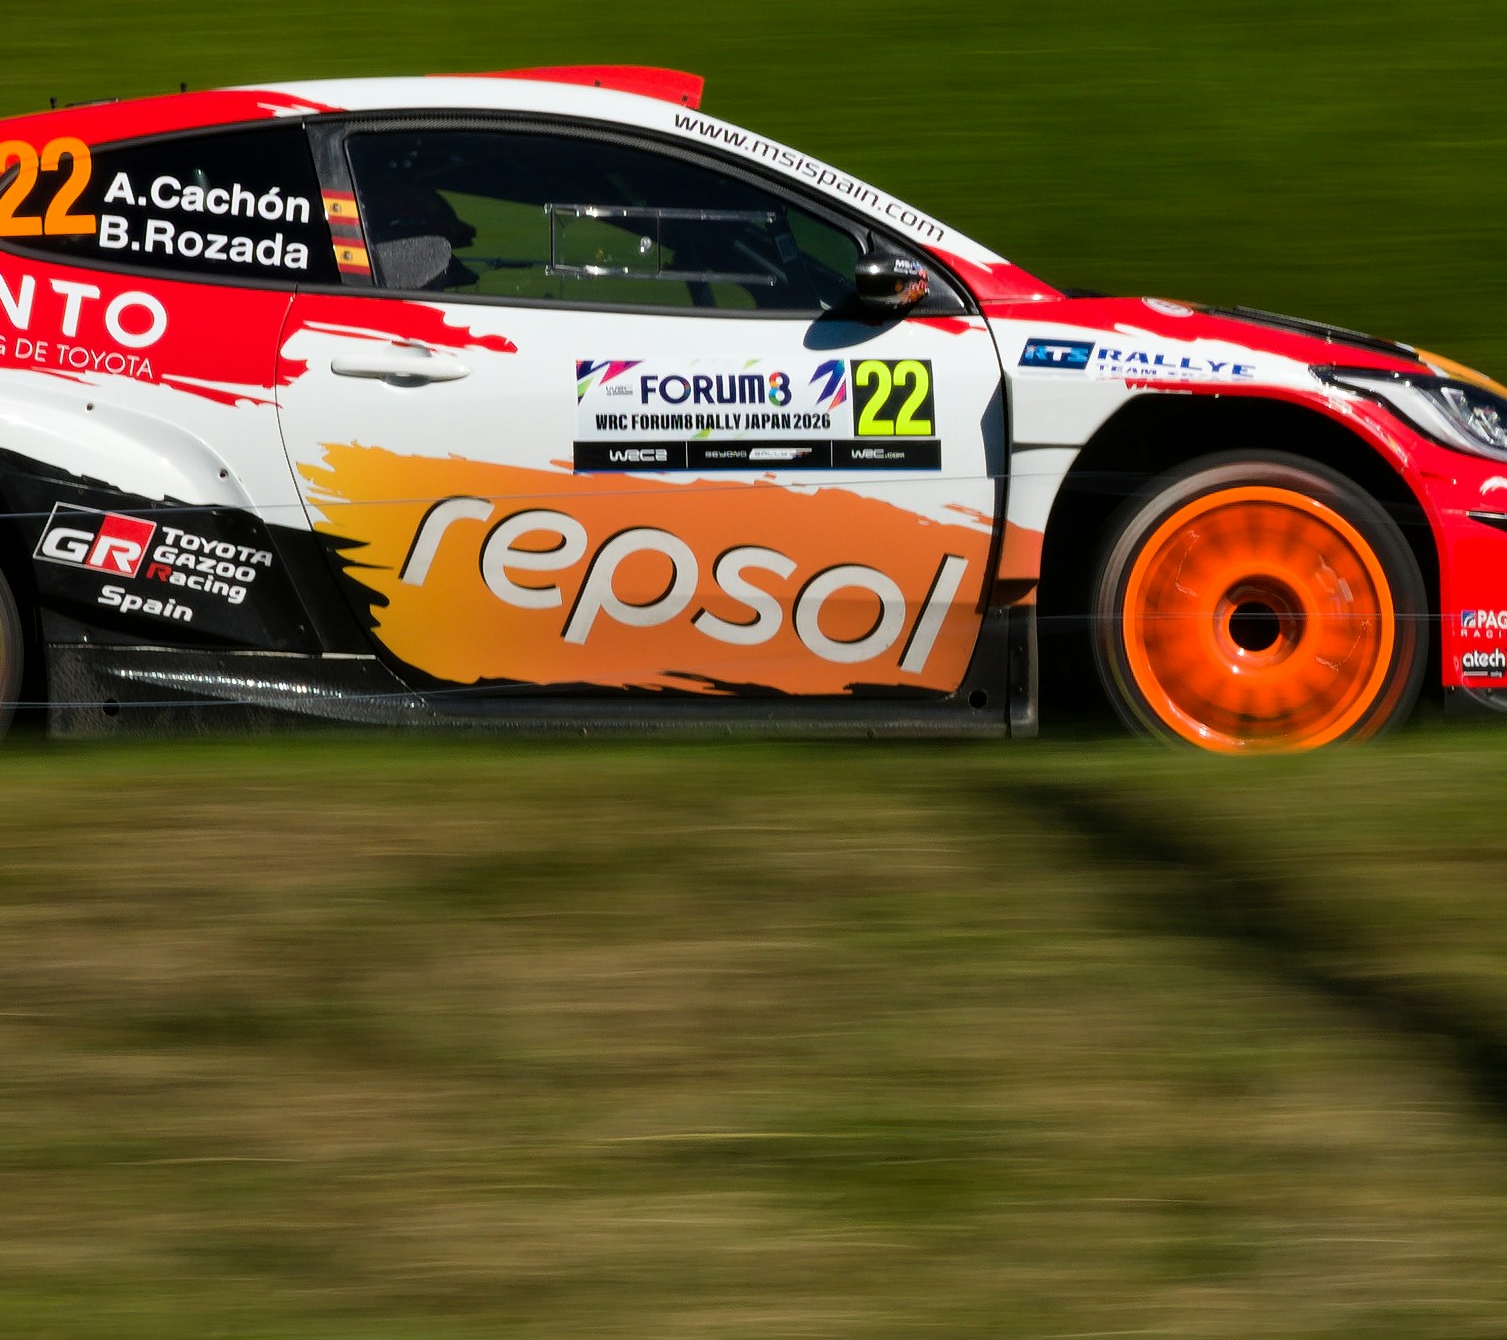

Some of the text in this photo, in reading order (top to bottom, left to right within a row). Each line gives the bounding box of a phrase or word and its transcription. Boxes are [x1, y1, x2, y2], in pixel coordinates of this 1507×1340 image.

[104, 171, 310, 223] A.Cachón
[674, 113, 945, 242] www.msispain.com
[99, 214, 309, 269] B.Rozada
[15, 337, 48, 362] DE
[57, 344, 153, 379] TOYOTA
[1097, 348, 1256, 378] RALLYE
[855, 360, 932, 436] 22
[595, 413, 831, 430] WRC FORUM8 RALLY JAPAN 2026
[41, 527, 143, 574] GR
[153, 545, 257, 583] GAZOO
[161, 526, 273, 567] TOYOTA
[97, 584, 194, 622] Spain
[146, 562, 247, 604] Racing
[398, 495, 969, 674] repsol
[1462, 647, 1506, 668] atech
